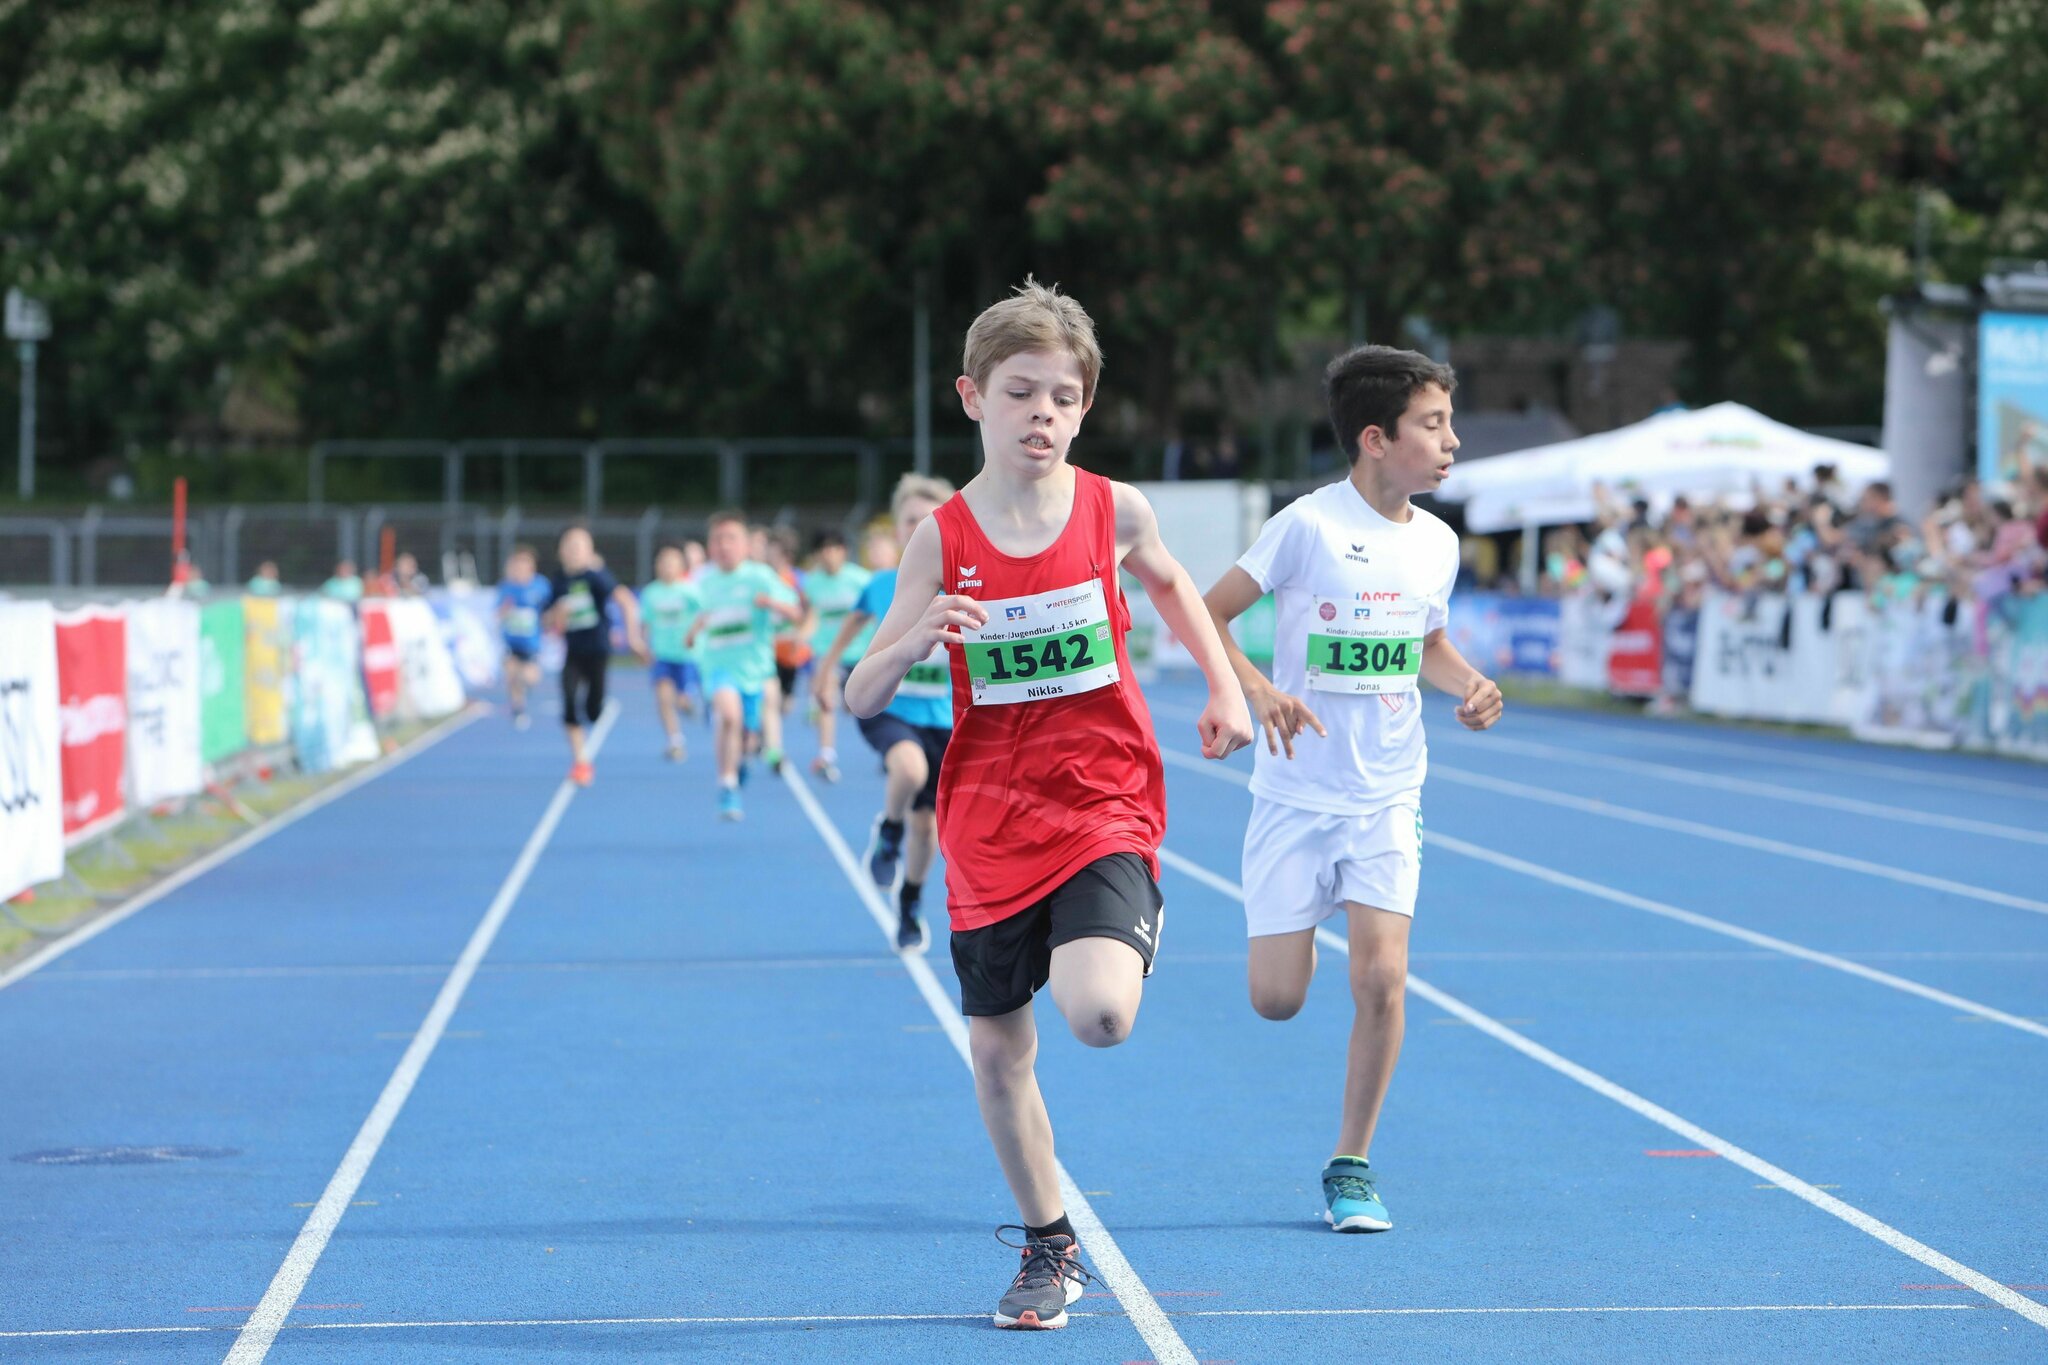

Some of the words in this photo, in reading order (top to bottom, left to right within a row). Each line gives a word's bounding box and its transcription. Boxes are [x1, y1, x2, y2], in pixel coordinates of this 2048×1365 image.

[1345, 553, 1369, 564] erima
[1052, 592, 1092, 609] INTERSPORT
[980, 624, 1056, 641] Kinder-/Jugendlauf
[1062, 620, 1074, 631] 1,5
[1075, 617, 1088, 627] km
[1326, 627, 1389, 637] Kinder-/Jugendlauf
[986, 633, 1095, 680] 1542
[1325, 641, 1407, 672] 1304
[1027, 684, 1064, 698] Niklas
[1354, 682, 1381, 691] Jonas
